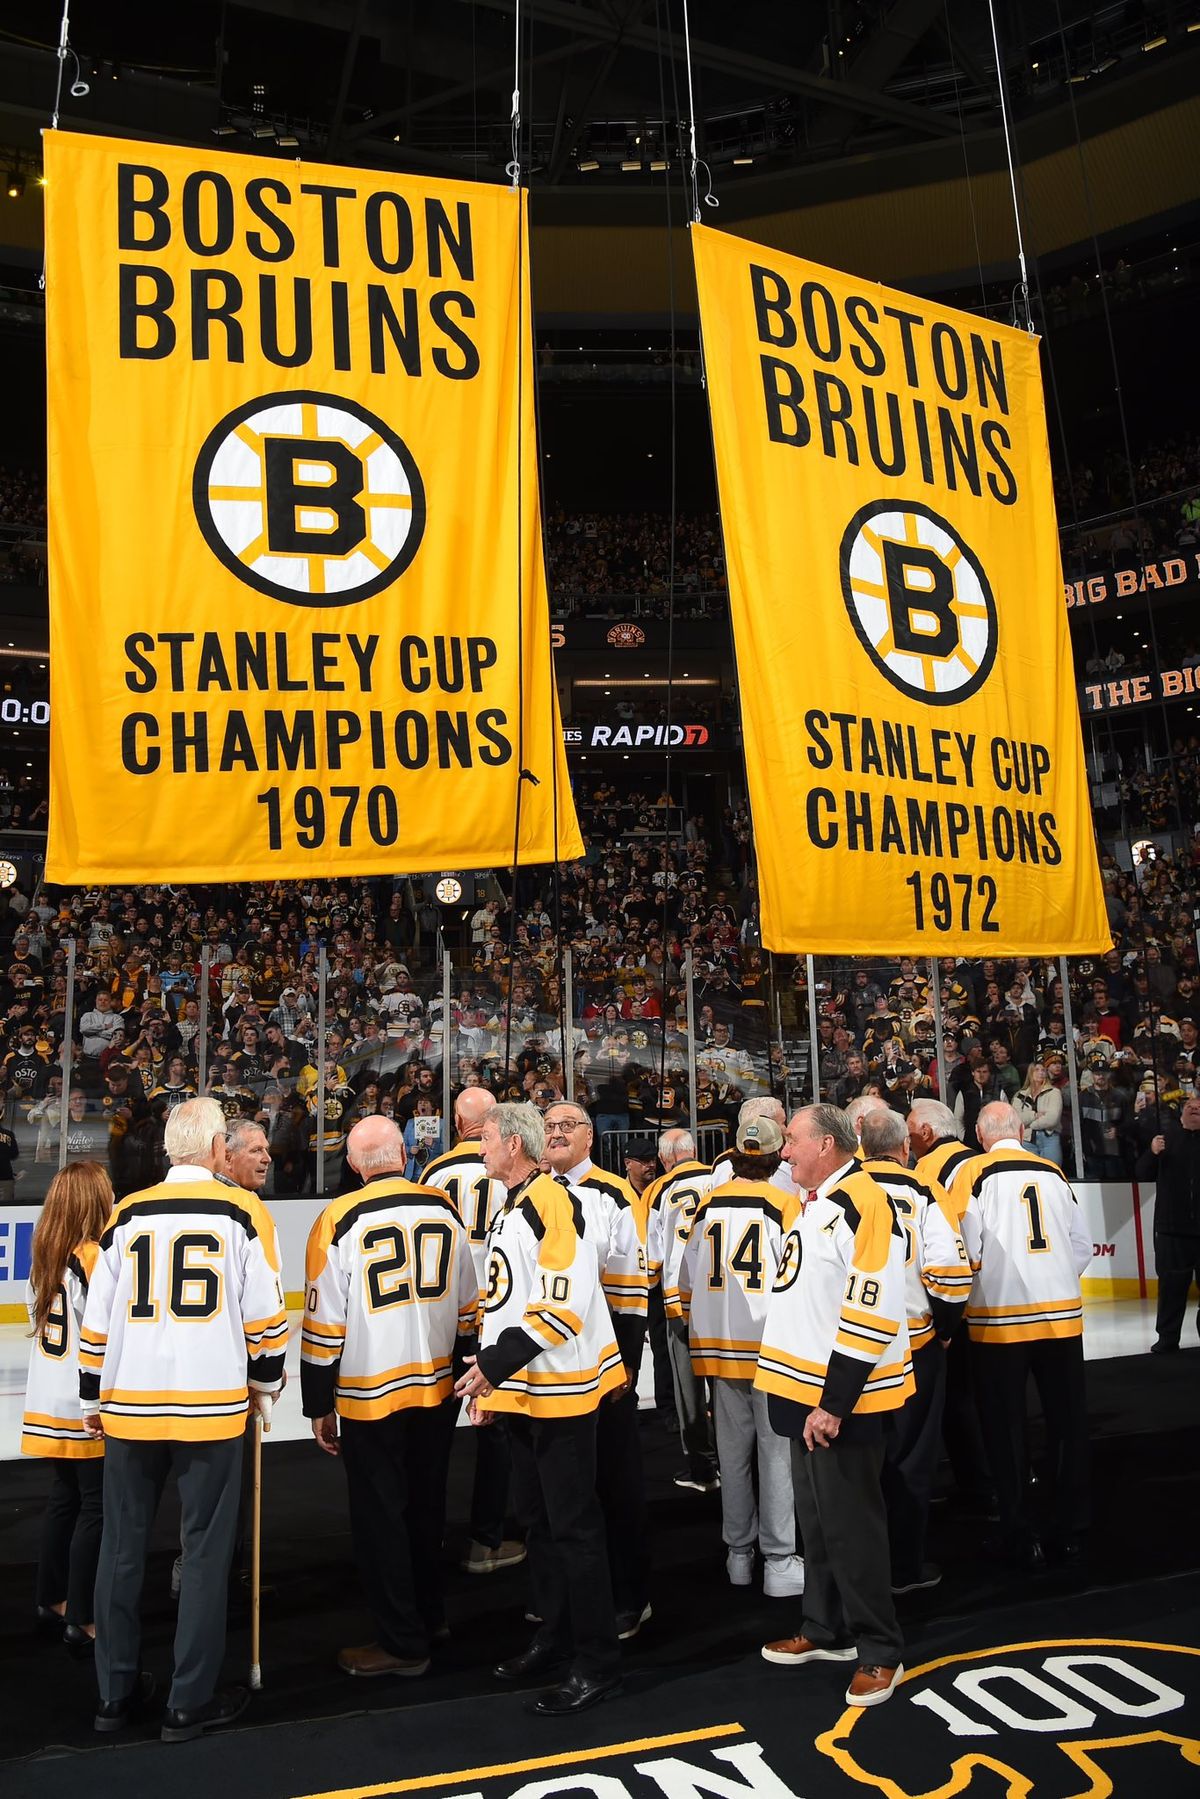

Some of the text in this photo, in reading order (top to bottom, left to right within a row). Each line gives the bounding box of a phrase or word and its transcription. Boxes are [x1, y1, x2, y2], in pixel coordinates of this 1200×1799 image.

[117, 163, 474, 282] BOSTON
[119, 263, 480, 380] BRUINS
[749, 263, 1009, 416] BOSTON
[759, 353, 1018, 506] BRUINS
[264, 437, 367, 556] B
[882, 540, 960, 658] B
[1064, 576, 1107, 608] BIG
[1115, 558, 1187, 598] BAD
[124, 632, 497, 694] STANLEY CUP
[1085, 667, 1200, 710] THE BI
[121, 708, 512, 775] CHAMPIONS
[804, 709, 1051, 796] STANLEY CUP
[257, 785, 399, 850] 1970
[805, 787, 1062, 866] CHAMPIONS
[906, 870, 1000, 932] 1972
[443, 1176, 493, 1243] 11
[822, 1213, 842, 1236] A
[1021, 1183, 1050, 1253] 1
[127, 1230, 223, 1322] 16
[362, 1222, 456, 1313] 20
[540, 1273, 571, 1302] 10
[706, 1220, 765, 1292] 14
[845, 1274, 881, 1308] 18
[910, 1655, 1185, 1736] 100
